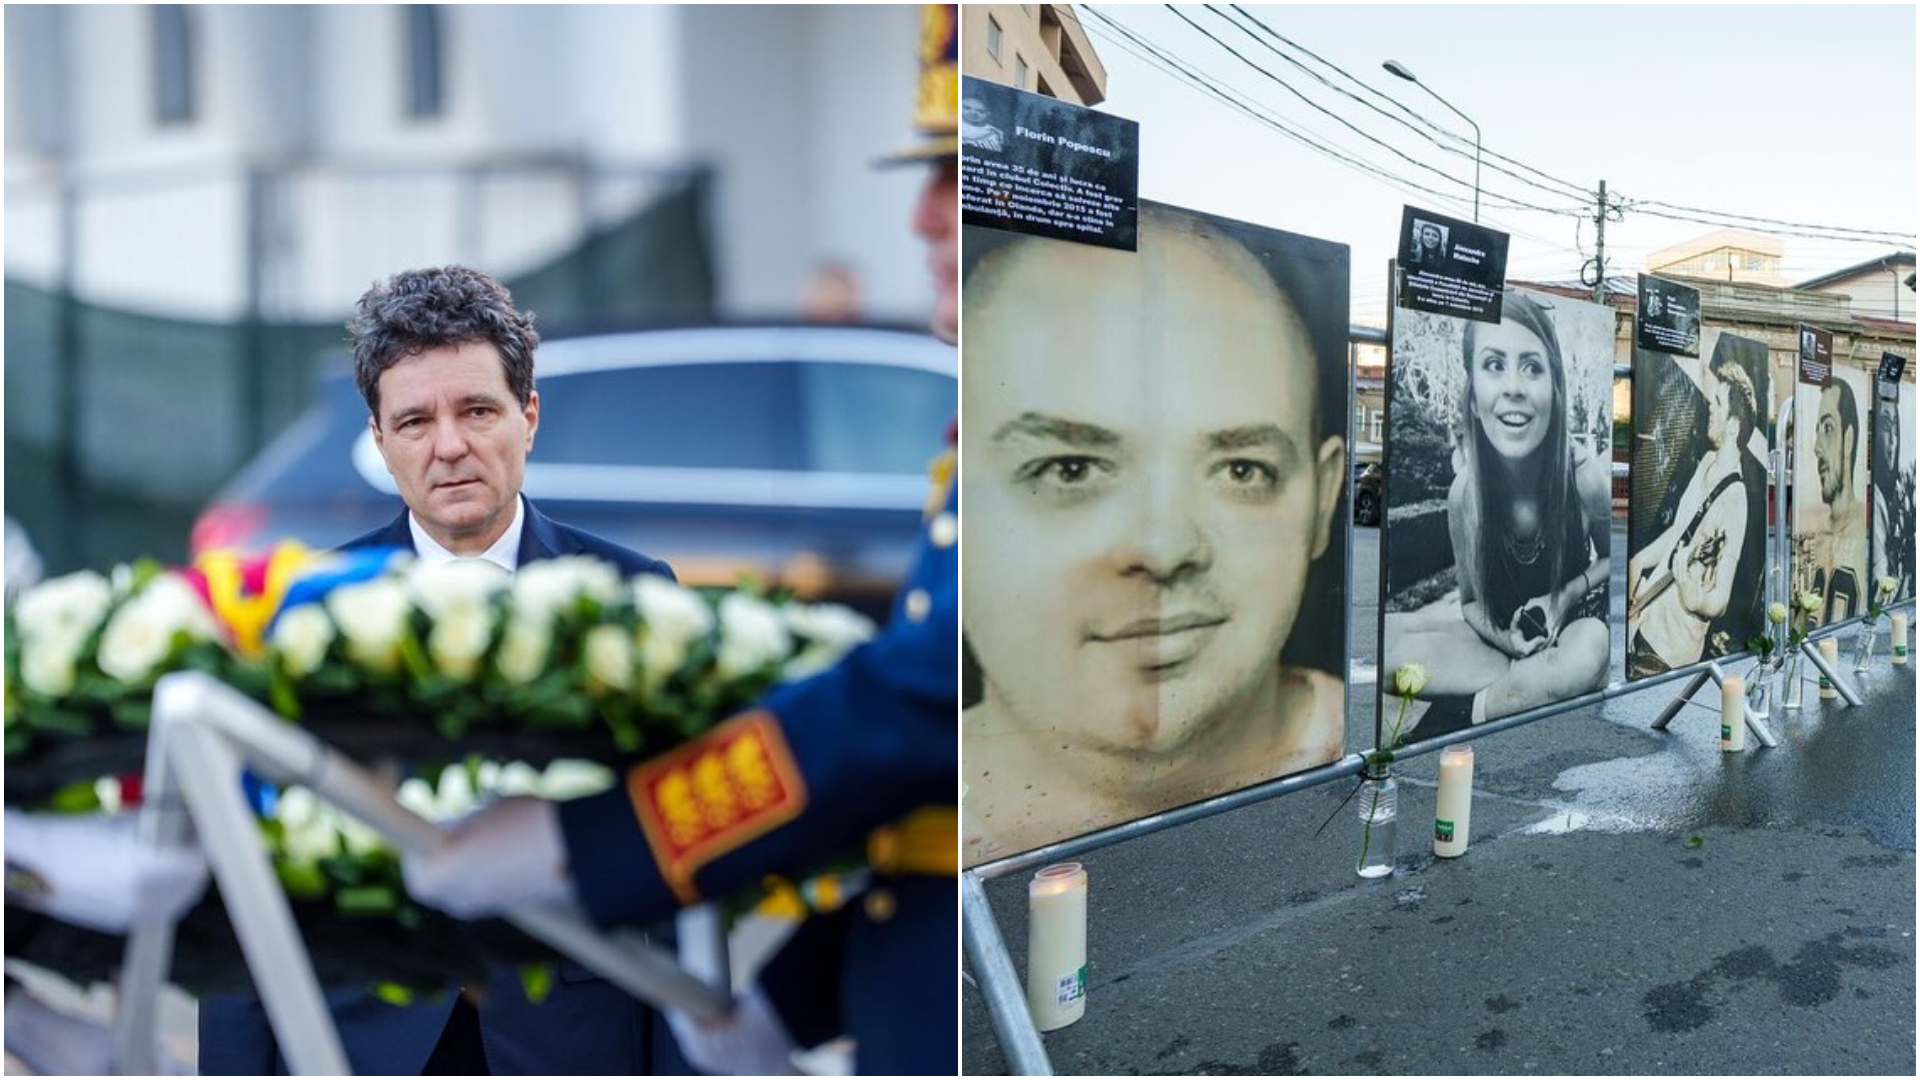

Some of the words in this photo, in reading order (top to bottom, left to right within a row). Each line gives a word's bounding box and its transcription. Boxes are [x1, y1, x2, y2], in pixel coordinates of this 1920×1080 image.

[1015, 126, 1055, 144] Florin
[1058, 137, 1111, 157] Popescu
[984, 160, 1009, 170] avea
[1027, 168, 1040, 177] de
[1042, 171, 1057, 180] ani
[1070, 177, 1094, 188] lucra
[1095, 183, 1106, 191] ca
[999, 171, 1031, 184] clubul
[1033, 178, 1075, 193] Colectiv.
[1076, 187, 1084, 196] A
[1086, 189, 1103, 199] fost
[1104, 194, 1124, 204] grav
[972, 175, 997, 187] timp
[999, 181, 1013, 190] ce
[1069, 194, 1102, 207] salveze
[1103, 201, 1120, 212] alte
[987, 187, 1000, 196] Pe
[1002, 190, 1010, 198] 7
[1012, 193, 1062, 207] noiembrie
[1063, 201, 1087, 213] 2015
[1096, 208, 1113, 218] fost
[1007, 201, 1046, 215] Olanda,
[1048, 208, 1064, 218] dar
[1066, 213, 1080, 221] s-a
[1082, 215, 1104, 226] stins
[1025, 213, 1051, 224] drum
[1054, 219, 1074, 229] spre
[1076, 222, 1104, 234] spital.
